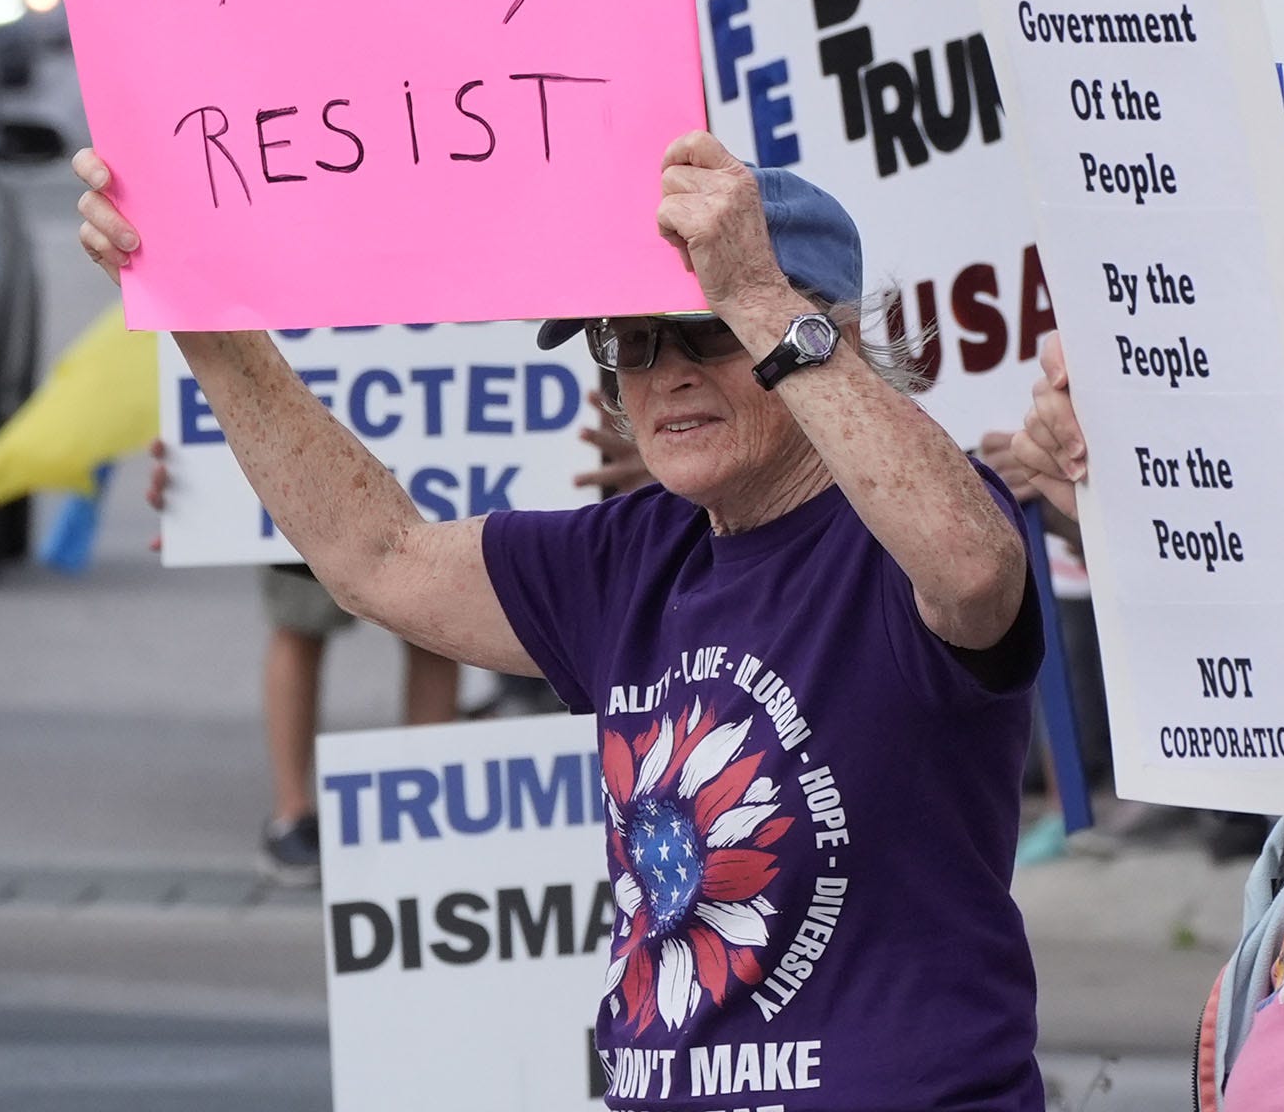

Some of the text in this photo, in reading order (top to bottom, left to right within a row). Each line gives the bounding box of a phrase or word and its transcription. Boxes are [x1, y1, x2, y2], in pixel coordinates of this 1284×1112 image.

[1018, 0, 1197, 44] Government
[1070, 79, 1162, 121] Of the
[1079, 152, 1178, 205] People
[1102, 262, 1196, 316] By the
[1115, 335, 1210, 388] People
[1135, 446, 1234, 489] For the
[1152, 519, 1245, 572] People
[605, 666, 672, 717] ALITY
[681, 646, 728, 685] LOVE
[1197, 656, 1253, 699] NOT
[798, 765, 851, 849] HOPE
[750, 876, 849, 1024] DIVERSITY
[689, 1040, 822, 1097] MAKE
